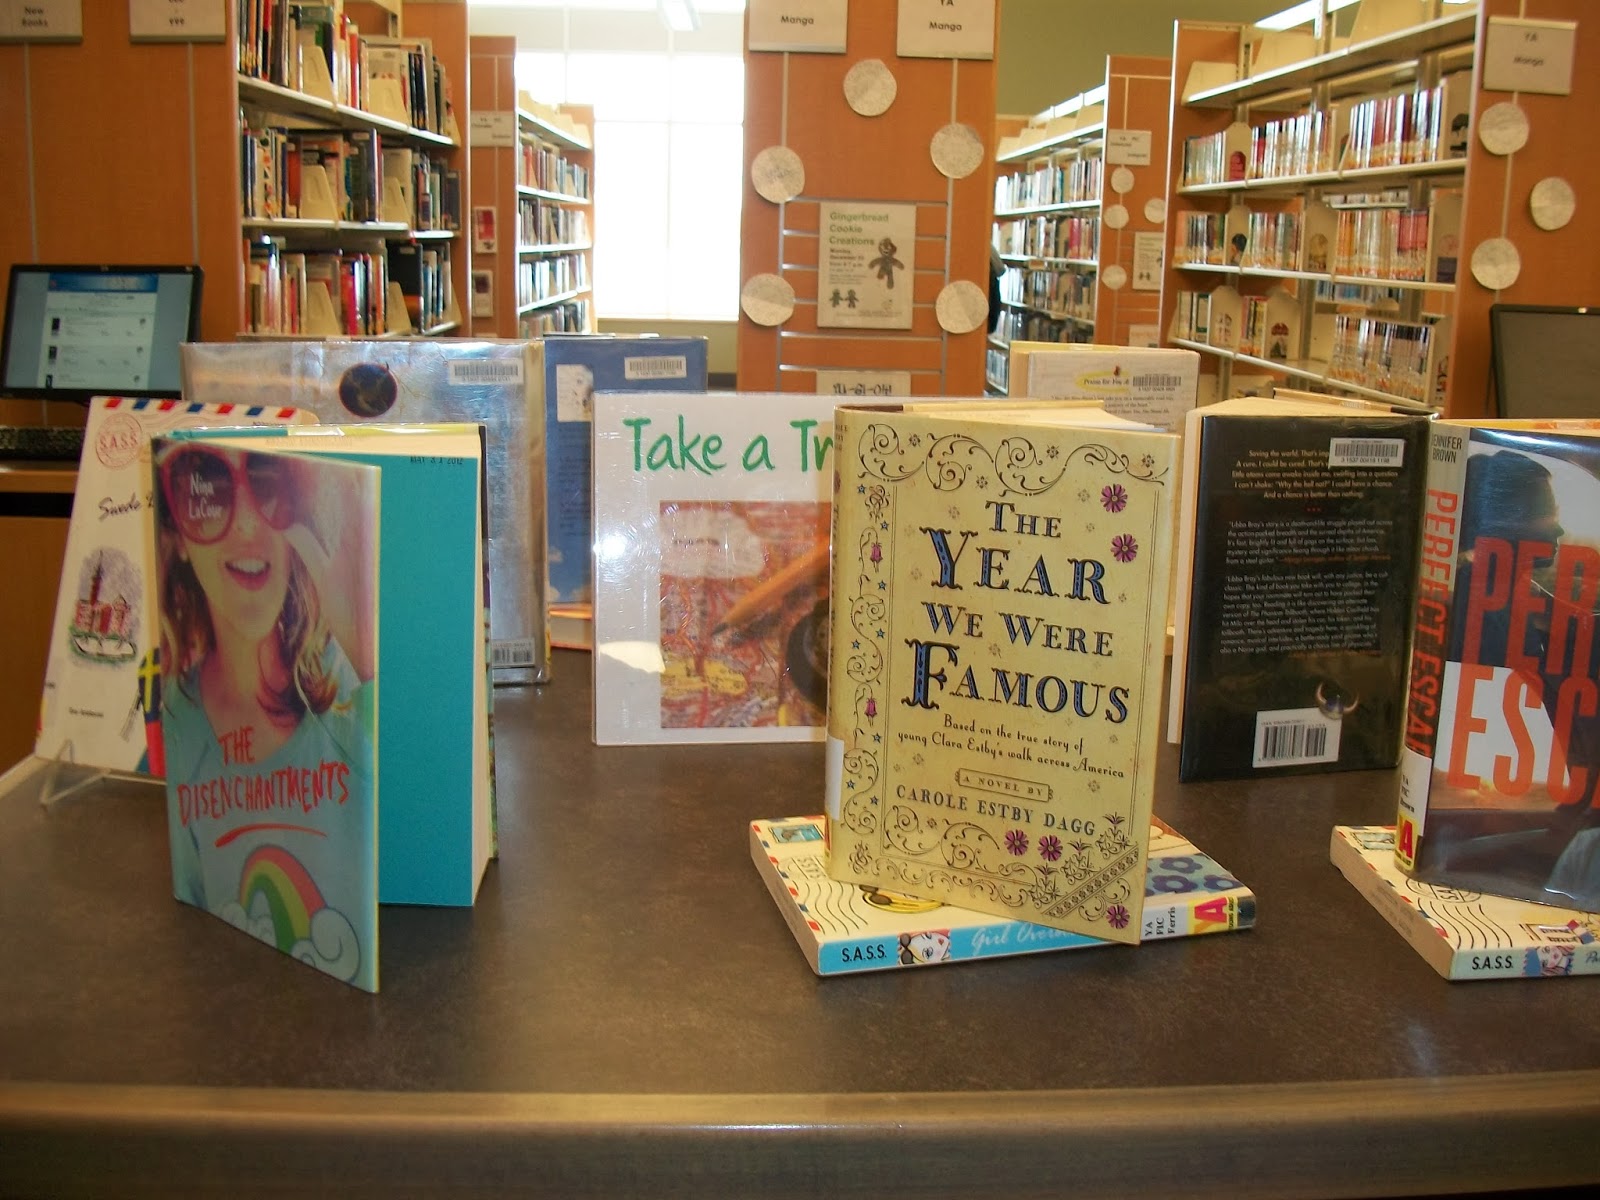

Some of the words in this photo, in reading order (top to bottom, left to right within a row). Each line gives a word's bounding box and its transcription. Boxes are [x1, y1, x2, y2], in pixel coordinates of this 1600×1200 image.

[25, 7, 44, 15] New
[780, 16, 814, 26] Manga
[929, 21, 962, 31] Manga
[829, 211, 889, 222] Gingerbread
[829, 224, 863, 233] Cookie
[829, 236, 875, 245] Creations
[623, 414, 727, 475] Take
[742, 435, 776, 472] a
[790, 419, 833, 472] Tr
[1432, 432, 1463, 450] JENNIFER
[1432, 447, 1457, 464] BROWN
[190, 471, 214, 497] Nina
[188, 497, 223, 520] LaCour
[985, 500, 1061, 538] THE
[919, 526, 1111, 604] YEAR
[1416, 488, 1458, 644] PERFECT
[1461, 536, 1600, 675] PER
[921, 601, 983, 638] WE
[998, 612, 1113, 657] WERE
[901, 638, 1129, 724] FAMOUS
[1404, 649, 1442, 757] ESCA
[218, 725, 256, 766] THE
[944, 713, 976, 733] Based
[980, 728, 991, 736] on
[996, 726, 1011, 739] the
[1017, 730, 1038, 744] true
[1043, 735, 1069, 753] story
[1074, 738, 1084, 755] of
[1446, 660, 1600, 808] ESC
[898, 732, 927, 745] young
[932, 731, 962, 749] Clara
[967, 738, 1003, 759] Estby's
[1008, 746, 1032, 761] walk
[1037, 755, 1069, 768] across
[1073, 757, 1124, 778] America
[176, 758, 350, 828] DISENCHANTMENTS
[978, 777, 1019, 792] NOVEL
[1028, 787, 1044, 796] BY
[896, 785, 968, 811] CAROLE
[977, 800, 1034, 823] ESTBY
[1044, 812, 1095, 836] DAGG
[1145, 921, 1152, 937] YA
[1156, 917, 1165, 935] FIC
[1167, 906, 1176, 933] Ferris
[842, 944, 887, 962] S.A.S.S.
[971, 925, 1011, 956] Girl
[1471, 955, 1514, 971] S.A.S.S.
